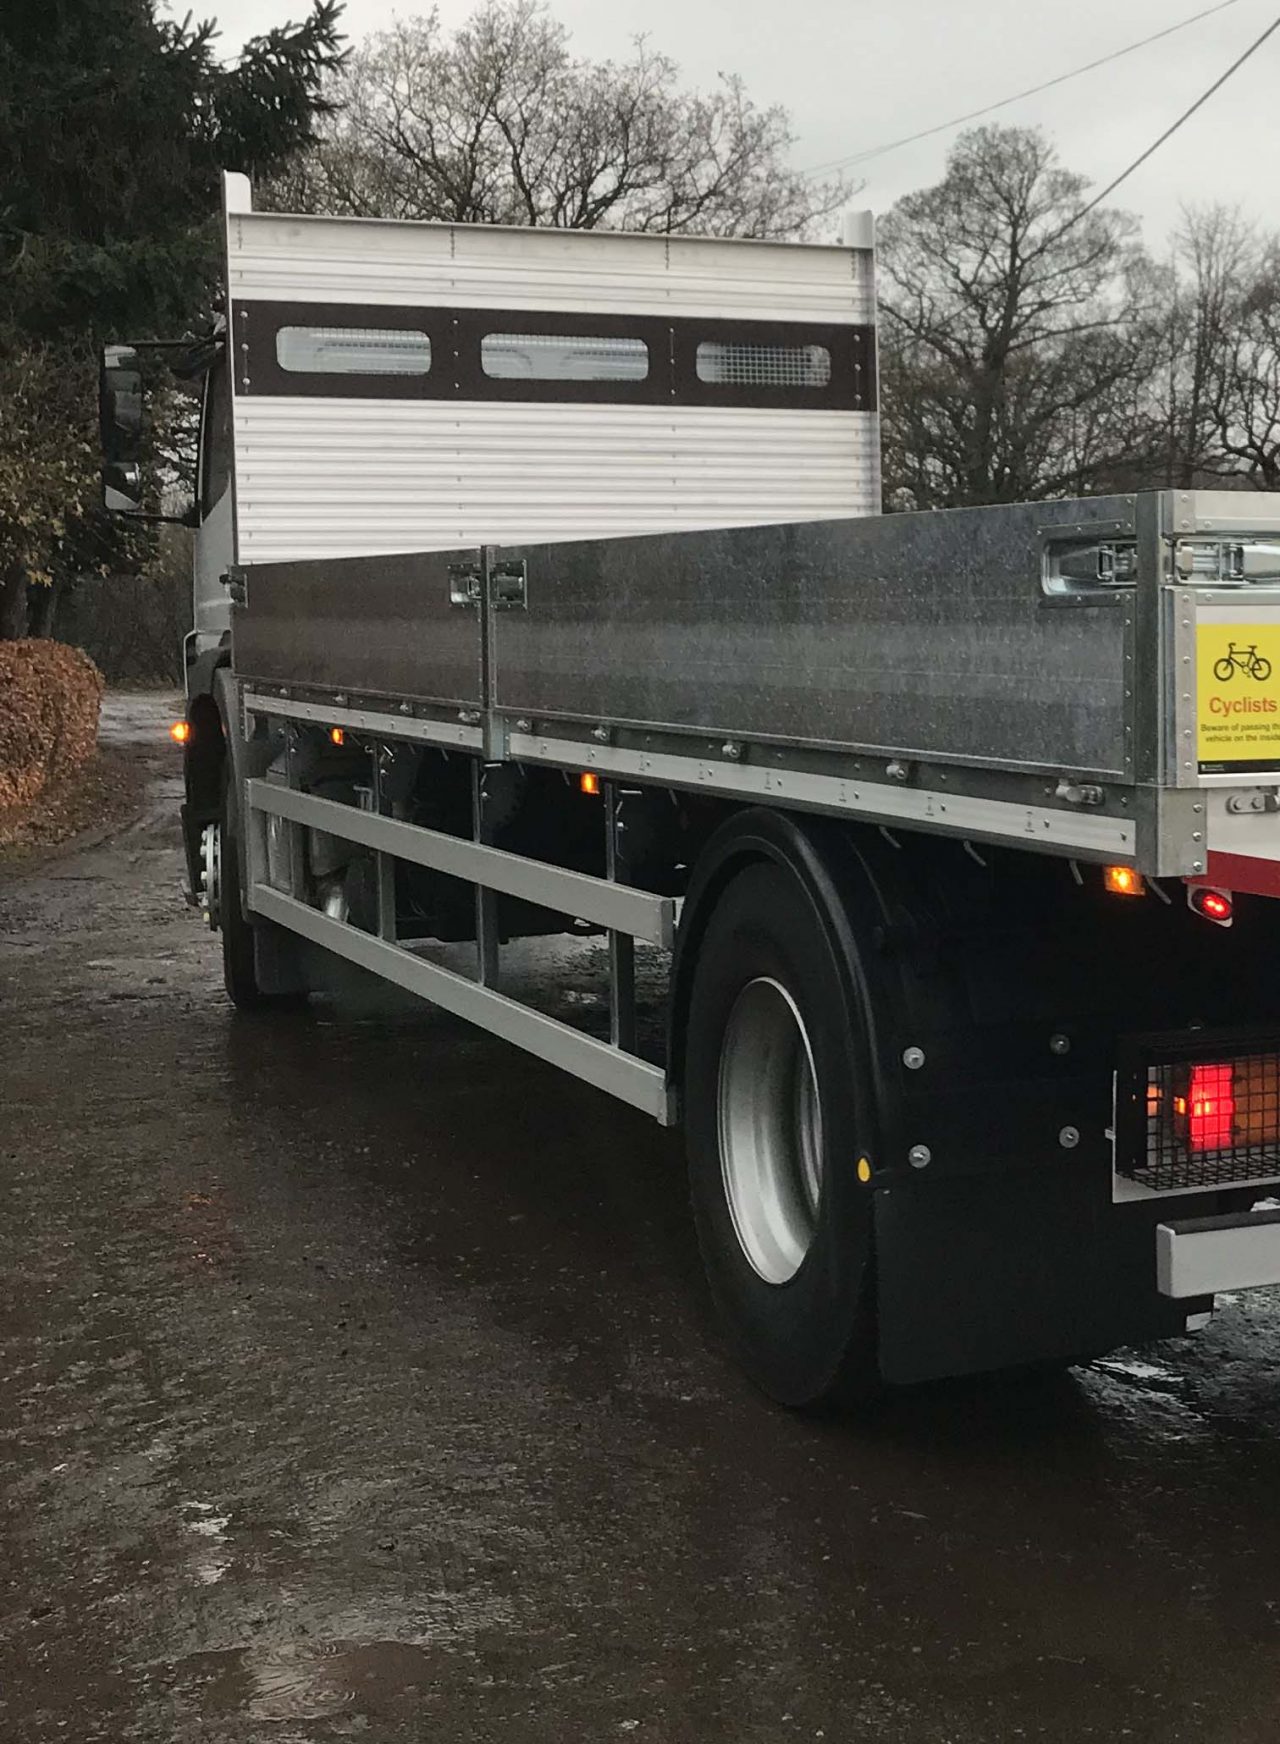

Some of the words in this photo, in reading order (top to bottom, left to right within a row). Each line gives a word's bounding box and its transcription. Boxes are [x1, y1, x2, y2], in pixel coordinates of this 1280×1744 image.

[1209, 696, 1278, 718] Cyclists
[1200, 723, 1229, 732] Beware
[1231, 723, 1239, 731] of
[1240, 723, 1270, 733] passing
